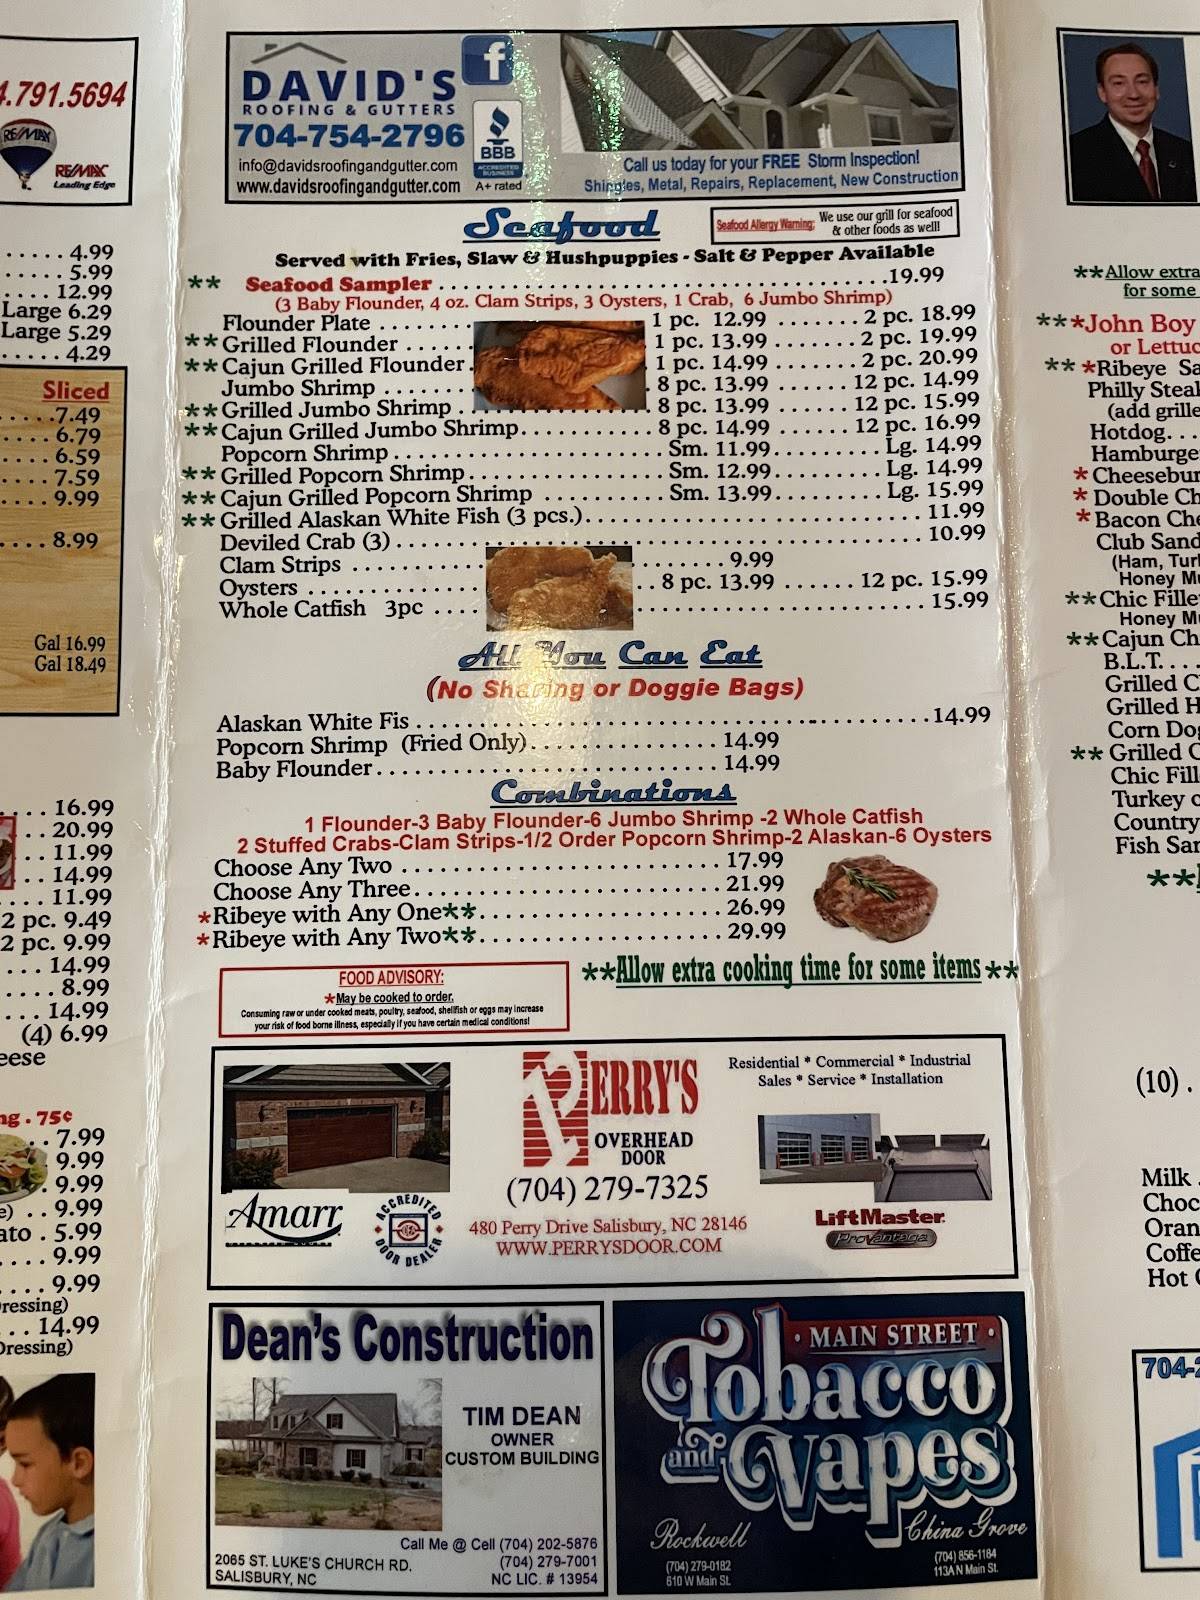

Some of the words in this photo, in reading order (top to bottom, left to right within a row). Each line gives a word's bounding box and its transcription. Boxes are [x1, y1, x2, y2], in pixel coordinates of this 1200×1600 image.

[243, 70, 456, 101] DAVID'S
[243, 104, 334, 115] ROOFING
[346, 104, 356, 115] &
[368, 103, 455, 115] GUTTERS
[234, 123, 465, 147] 704-754-2796
[481, 147, 515, 159] BBB
[624, 158, 649, 172] Call
[654, 161, 667, 171] us
[670, 157, 706, 174] today
[710, 157, 726, 171] for
[730, 160, 759, 173] your
[762, 154, 800, 169] FREE
[808, 154, 847, 168] Storm
[850, 150, 920, 168] Inspection!
[55, 164, 109, 178] RE/MAX
[239, 158, 458, 175] info@davidsroofingandgutter.com
[53, 181, 91, 190] Leading
[93, 181, 116, 191] Edge
[237, 178, 461, 197] www.davidsroofingandgutter.com
[476, 181, 491, 191] A+
[495, 181, 522, 191] rated
[648, 176, 687, 192] Metal,
[691, 176, 744, 192] Repairs,
[748, 174, 837, 191] Replacement,
[841, 173, 869, 187] New
[872, 169, 958, 185] Construction
[819, 212, 835, 222] We
[837, 213, 854, 222] use
[857, 212, 874, 221] our
[876, 209, 894, 223] grill
[897, 209, 911, 219] for
[914, 206, 953, 219] seafood
[463, 208, 660, 245] Seafood
[717, 219, 748, 230] Seafood
[750, 219, 779, 232] Allergy
[832, 226, 841, 236] &
[844, 225, 870, 236] other
[873, 224, 900, 235] foods
[903, 225, 914, 234] as
[917, 221, 940, 233] well!
[70, 244, 113, 261] 4.99
[275, 253, 345, 268] Served
[351, 252, 400, 267] with
[406, 252, 461, 269] Fries,
[468, 251, 518, 265] Slaw
[523, 250, 541, 265] &
[546, 249, 678, 269] Hushpuppies
[694, 249, 735, 263] Salt
[740, 249, 756, 262] &
[762, 247, 834, 265] Pepper
[839, 243, 935, 260] Available
[246, 277, 333, 292] Seafood
[340, 277, 432, 294] Sampler
[2, 304, 61, 322] Large
[68, 304, 112, 320] 6.29
[223, 314, 316, 331] Flounder
[321, 314, 370, 331] Plate
[653, 314, 661, 327] 1
[670, 315, 700, 332] pc.
[714, 311, 766, 328] 12.99
[864, 310, 876, 324] 2
[883, 310, 913, 327] pc.
[922, 304, 976, 322] 18.99
[43, 380, 109, 400] Sliced
[1088, 381, 1145, 401] Philly
[56, 427, 101, 444] 6.79
[1095, 510, 1160, 528] Bacon
[53, 532, 98, 548] 8.99
[220, 556, 275, 575] Clam
[282, 554, 341, 575] Strips
[730, 551, 774, 567] 9.99
[219, 579, 298, 600] Oysters
[1100, 590, 1148, 607] Chic
[220, 601, 288, 619] Whole
[294, 600, 366, 618] Catfish
[385, 600, 423, 617] 3pc
[932, 591, 989, 609] 15.99
[34, 634, 60, 652] Gal
[67, 635, 106, 652] 16.99
[458, 641, 520, 668] All
[534, 640, 606, 667] You
[618, 640, 688, 666] Can
[700, 639, 763, 666] Eat
[34, 655, 61, 673] Gal
[67, 655, 106, 673] 18.49
[628, 677, 720, 700] Doggie
[216, 714, 302, 732] Alaskan
[308, 713, 373, 731] White
[380, 711, 409, 729] Fis
[933, 706, 991, 725] 14.99
[216, 761, 270, 782] Baby
[276, 759, 373, 778] Flounder
[491, 779, 737, 806] Combinations
[1112, 789, 1184, 809] Turkey
[55, 799, 114, 816] 16.99
[214, 859, 292, 877] Choose
[298, 857, 342, 880] Any
[348, 857, 392, 874] Two
[727, 851, 784, 870] 17.99
[339, 971, 374, 985] FOOD
[378, 969, 444, 984] ADVISORY:
[728, 1055, 799, 1069] Residential
[816, 1055, 894, 1068] Commercial
[910, 1053, 971, 1067] Industrial
[758, 1073, 792, 1087] Sales
[807, 1073, 856, 1086] Service
[871, 1072, 943, 1085] Installation
[57, 1128, 105, 1148] 7.99
[594, 1131, 694, 1150] OVERHEAD
[621, 1149, 666, 1166] DOOR
[1141, 1168, 1190, 1187] Milk
[507, 1178, 576, 1208] (704)
[585, 1174, 708, 1201] 279-7325
[469, 1221, 497, 1235] 480
[502, 1220, 541, 1238] Perry
[546, 1219, 590, 1235] Drive
[592, 1217, 664, 1237] Salisbury,
[671, 1217, 694, 1232] NC
[702, 1215, 747, 1231] 28146
[495, 1236, 722, 1256] WWW.PERRYSDOOR.COM
[39, 1316, 99, 1337] 14.99
[354, 1311, 594, 1362] Construction
[809, 1325, 878, 1349] MAIN
[887, 1322, 978, 1347] STREET
[648, 1302, 997, 1423] Tobacco
[463, 1407, 504, 1426] TIM
[511, 1406, 581, 1426] DEAN
[491, 1432, 554, 1447] OWNER
[445, 1451, 516, 1466] CUSTOM
[520, 1450, 600, 1465] BUILDING
[728, 1426, 1003, 1527] Vapes
[904, 1510, 964, 1541] China
[968, 1506, 1028, 1538] Grove
[650, 1518, 752, 1550] Rockwell
[666, 1560, 688, 1575] (704)
[215, 1570, 294, 1587] SALISBURY,
[297, 1573, 317, 1586] NC
[559, 1572, 598, 1585] 13954
